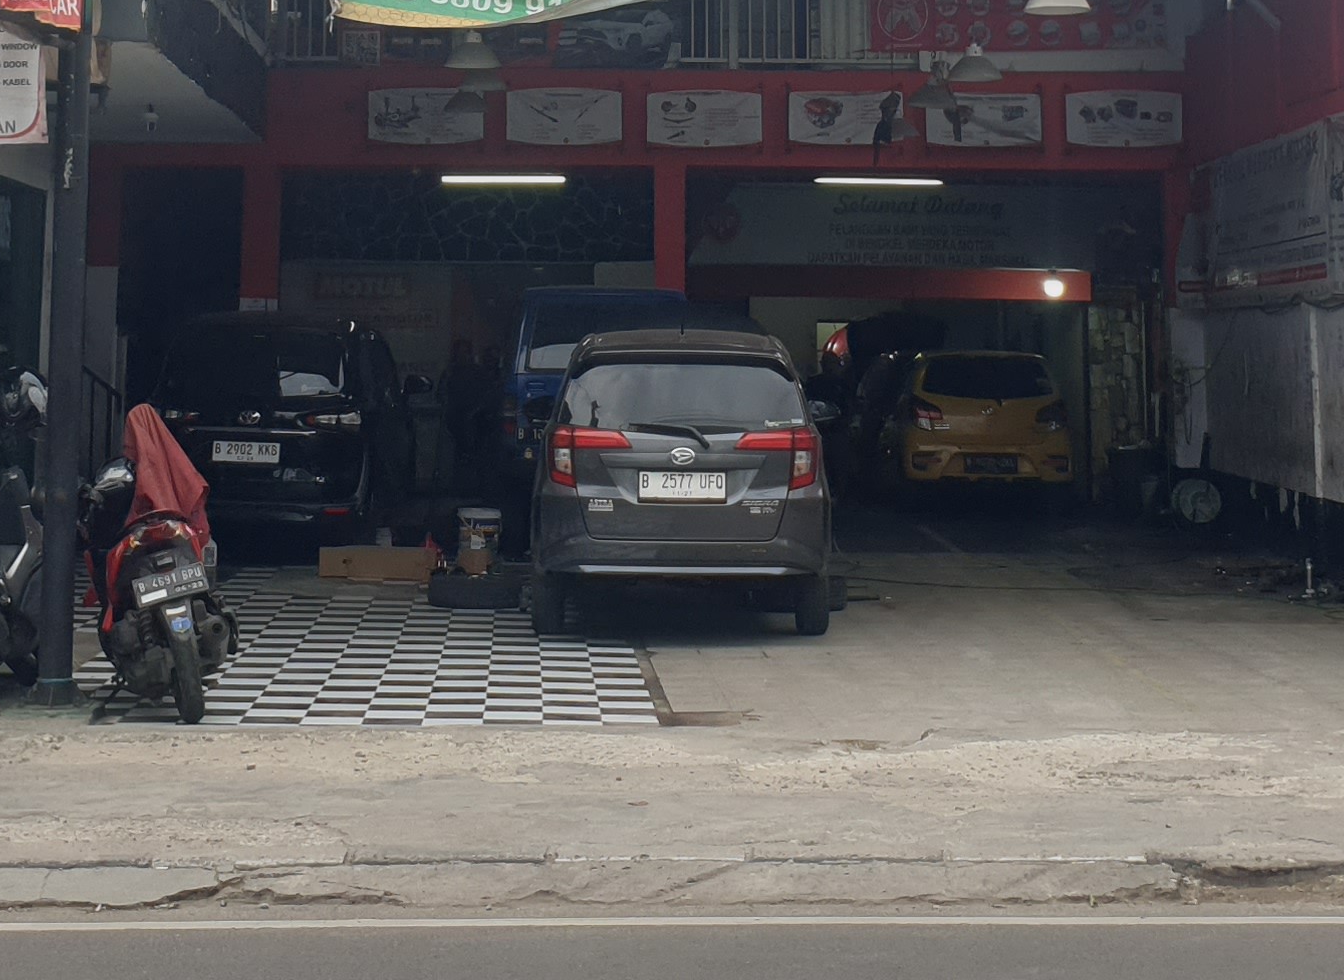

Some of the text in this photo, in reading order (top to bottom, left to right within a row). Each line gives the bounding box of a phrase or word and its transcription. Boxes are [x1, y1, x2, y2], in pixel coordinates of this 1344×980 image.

[833, 193, 1004, 220] Selamat Datang
[215, 443, 221, 454] B
[227, 443, 253, 456] 2902
[642, 474, 649, 489] B
[662, 474, 693, 489] 2577
[138, 566, 203, 593] B 4691 BPU
